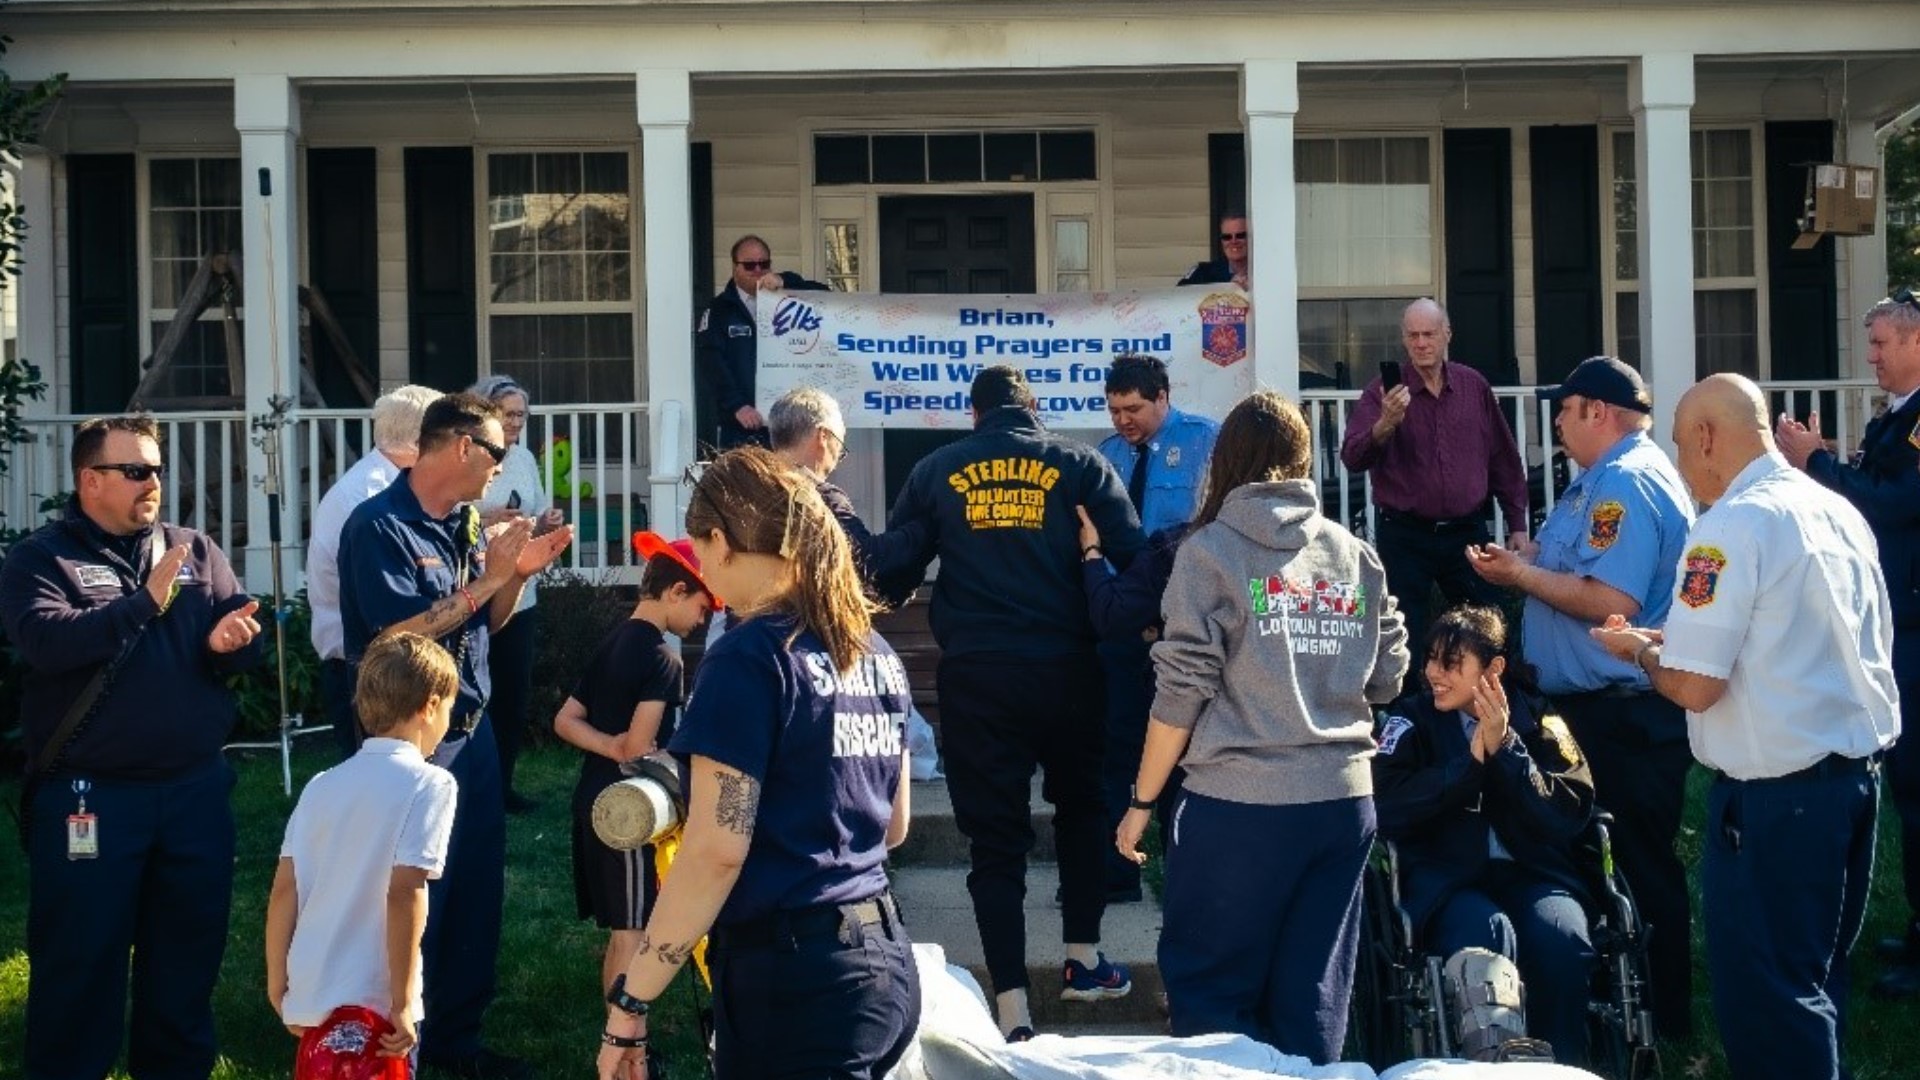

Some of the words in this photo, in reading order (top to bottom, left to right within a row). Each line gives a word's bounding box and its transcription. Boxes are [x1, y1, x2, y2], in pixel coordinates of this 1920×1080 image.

[772, 300, 823, 336] Elks
[958, 308, 1055, 328] Brian,
[837, 332, 967, 359] Sending
[974, 334, 1103, 359] Prayers
[1111, 333, 1171, 352] and
[872, 361, 938, 383] Well
[945, 362, 1062, 383] Wies
[948, 457, 1060, 493] STERLING
[966, 488, 1045, 506] VOLUNTEER
[992, 502, 1045, 522] COMPANY
